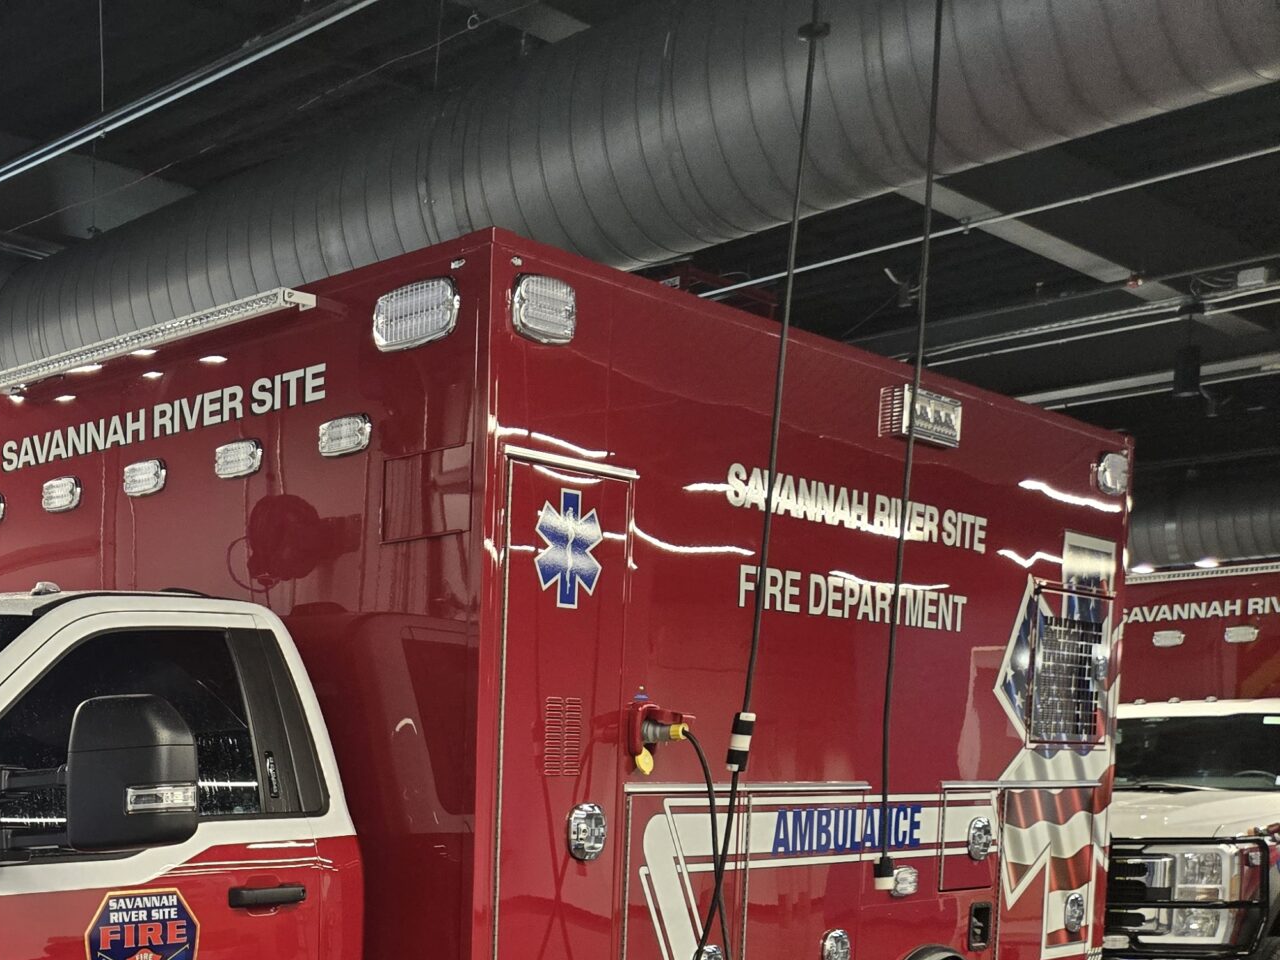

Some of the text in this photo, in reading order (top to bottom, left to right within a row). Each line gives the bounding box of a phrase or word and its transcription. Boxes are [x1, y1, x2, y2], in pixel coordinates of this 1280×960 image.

[1, 363, 327, 472] SAVANNAH RIVER SITE
[726, 463, 988, 554] SAVANNAH RIVER SITE
[808, 572, 967, 632] DEPARTMENT
[772, 805, 922, 856] AMBULANCE
[108, 895, 177, 911] SAVANNAH
[109, 908, 178, 923] RIVER SITE
[98, 920, 187, 950] FIRE
